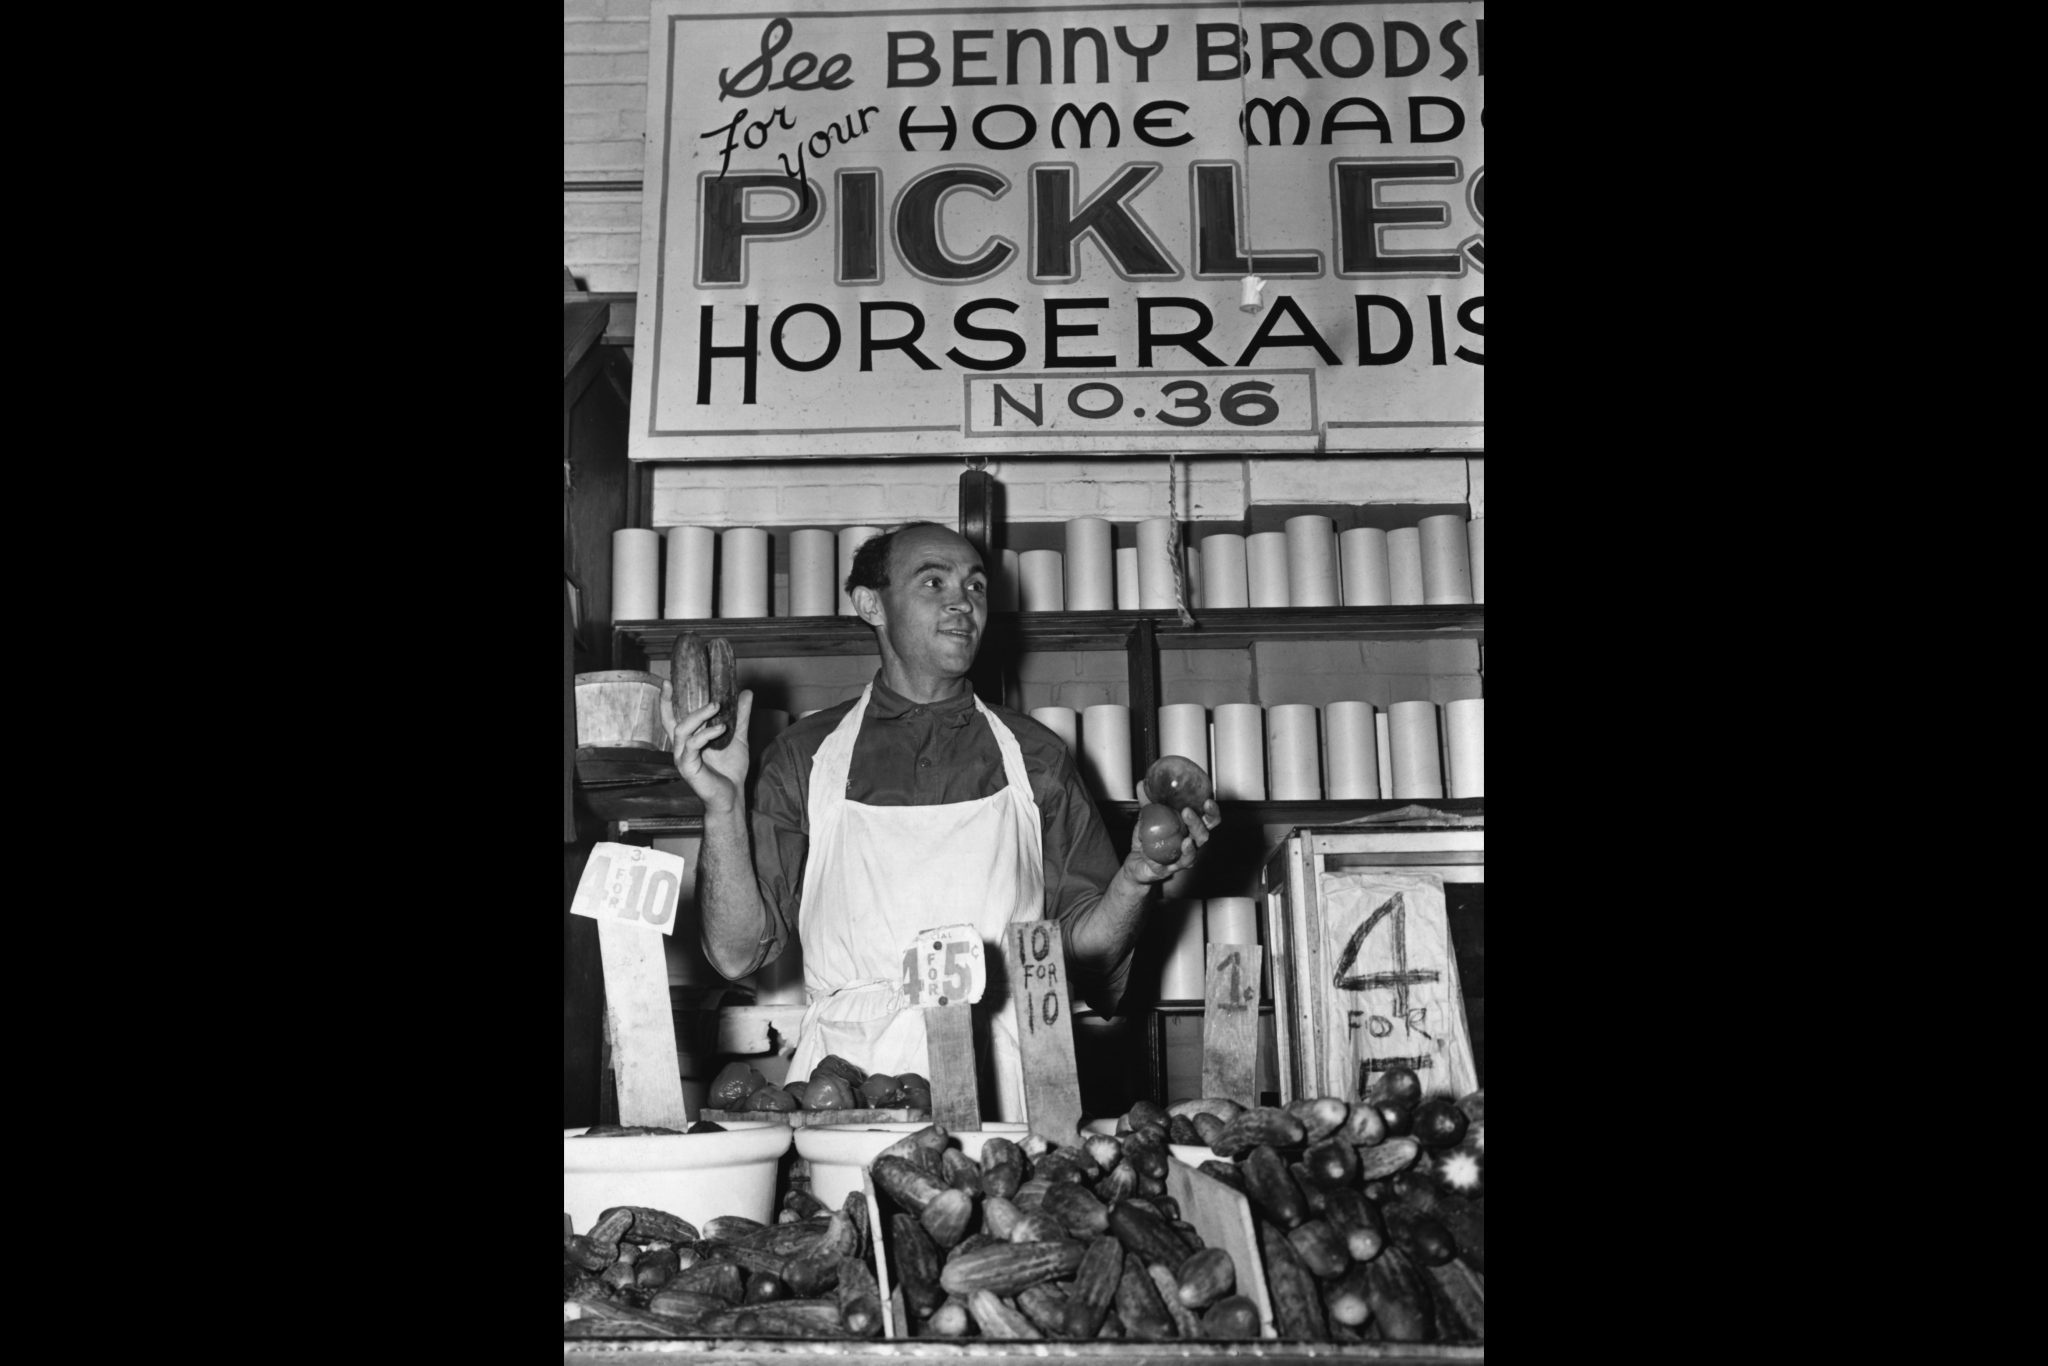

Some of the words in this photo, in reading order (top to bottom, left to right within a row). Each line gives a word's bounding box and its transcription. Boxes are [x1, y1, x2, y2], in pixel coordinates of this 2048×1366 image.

[718, 16, 854, 102] See
[1195, 19, 1484, 82] BRODS
[777, 105, 880, 216] your
[899, 100, 1195, 151] HOME
[1238, 95, 1484, 147] MAD
[693, 153, 1484, 290] PICKLE
[608, 868, 626, 909] FOR
[617, 865, 679, 925] 10
[1017, 925, 1050, 965] 10
[1333, 891, 1440, 1019] 4
[902, 947, 925, 1005] 4
[927, 952, 939, 996] FOR
[1021, 962, 1058, 989] FOR
[1028, 991, 1059, 1035] 10
